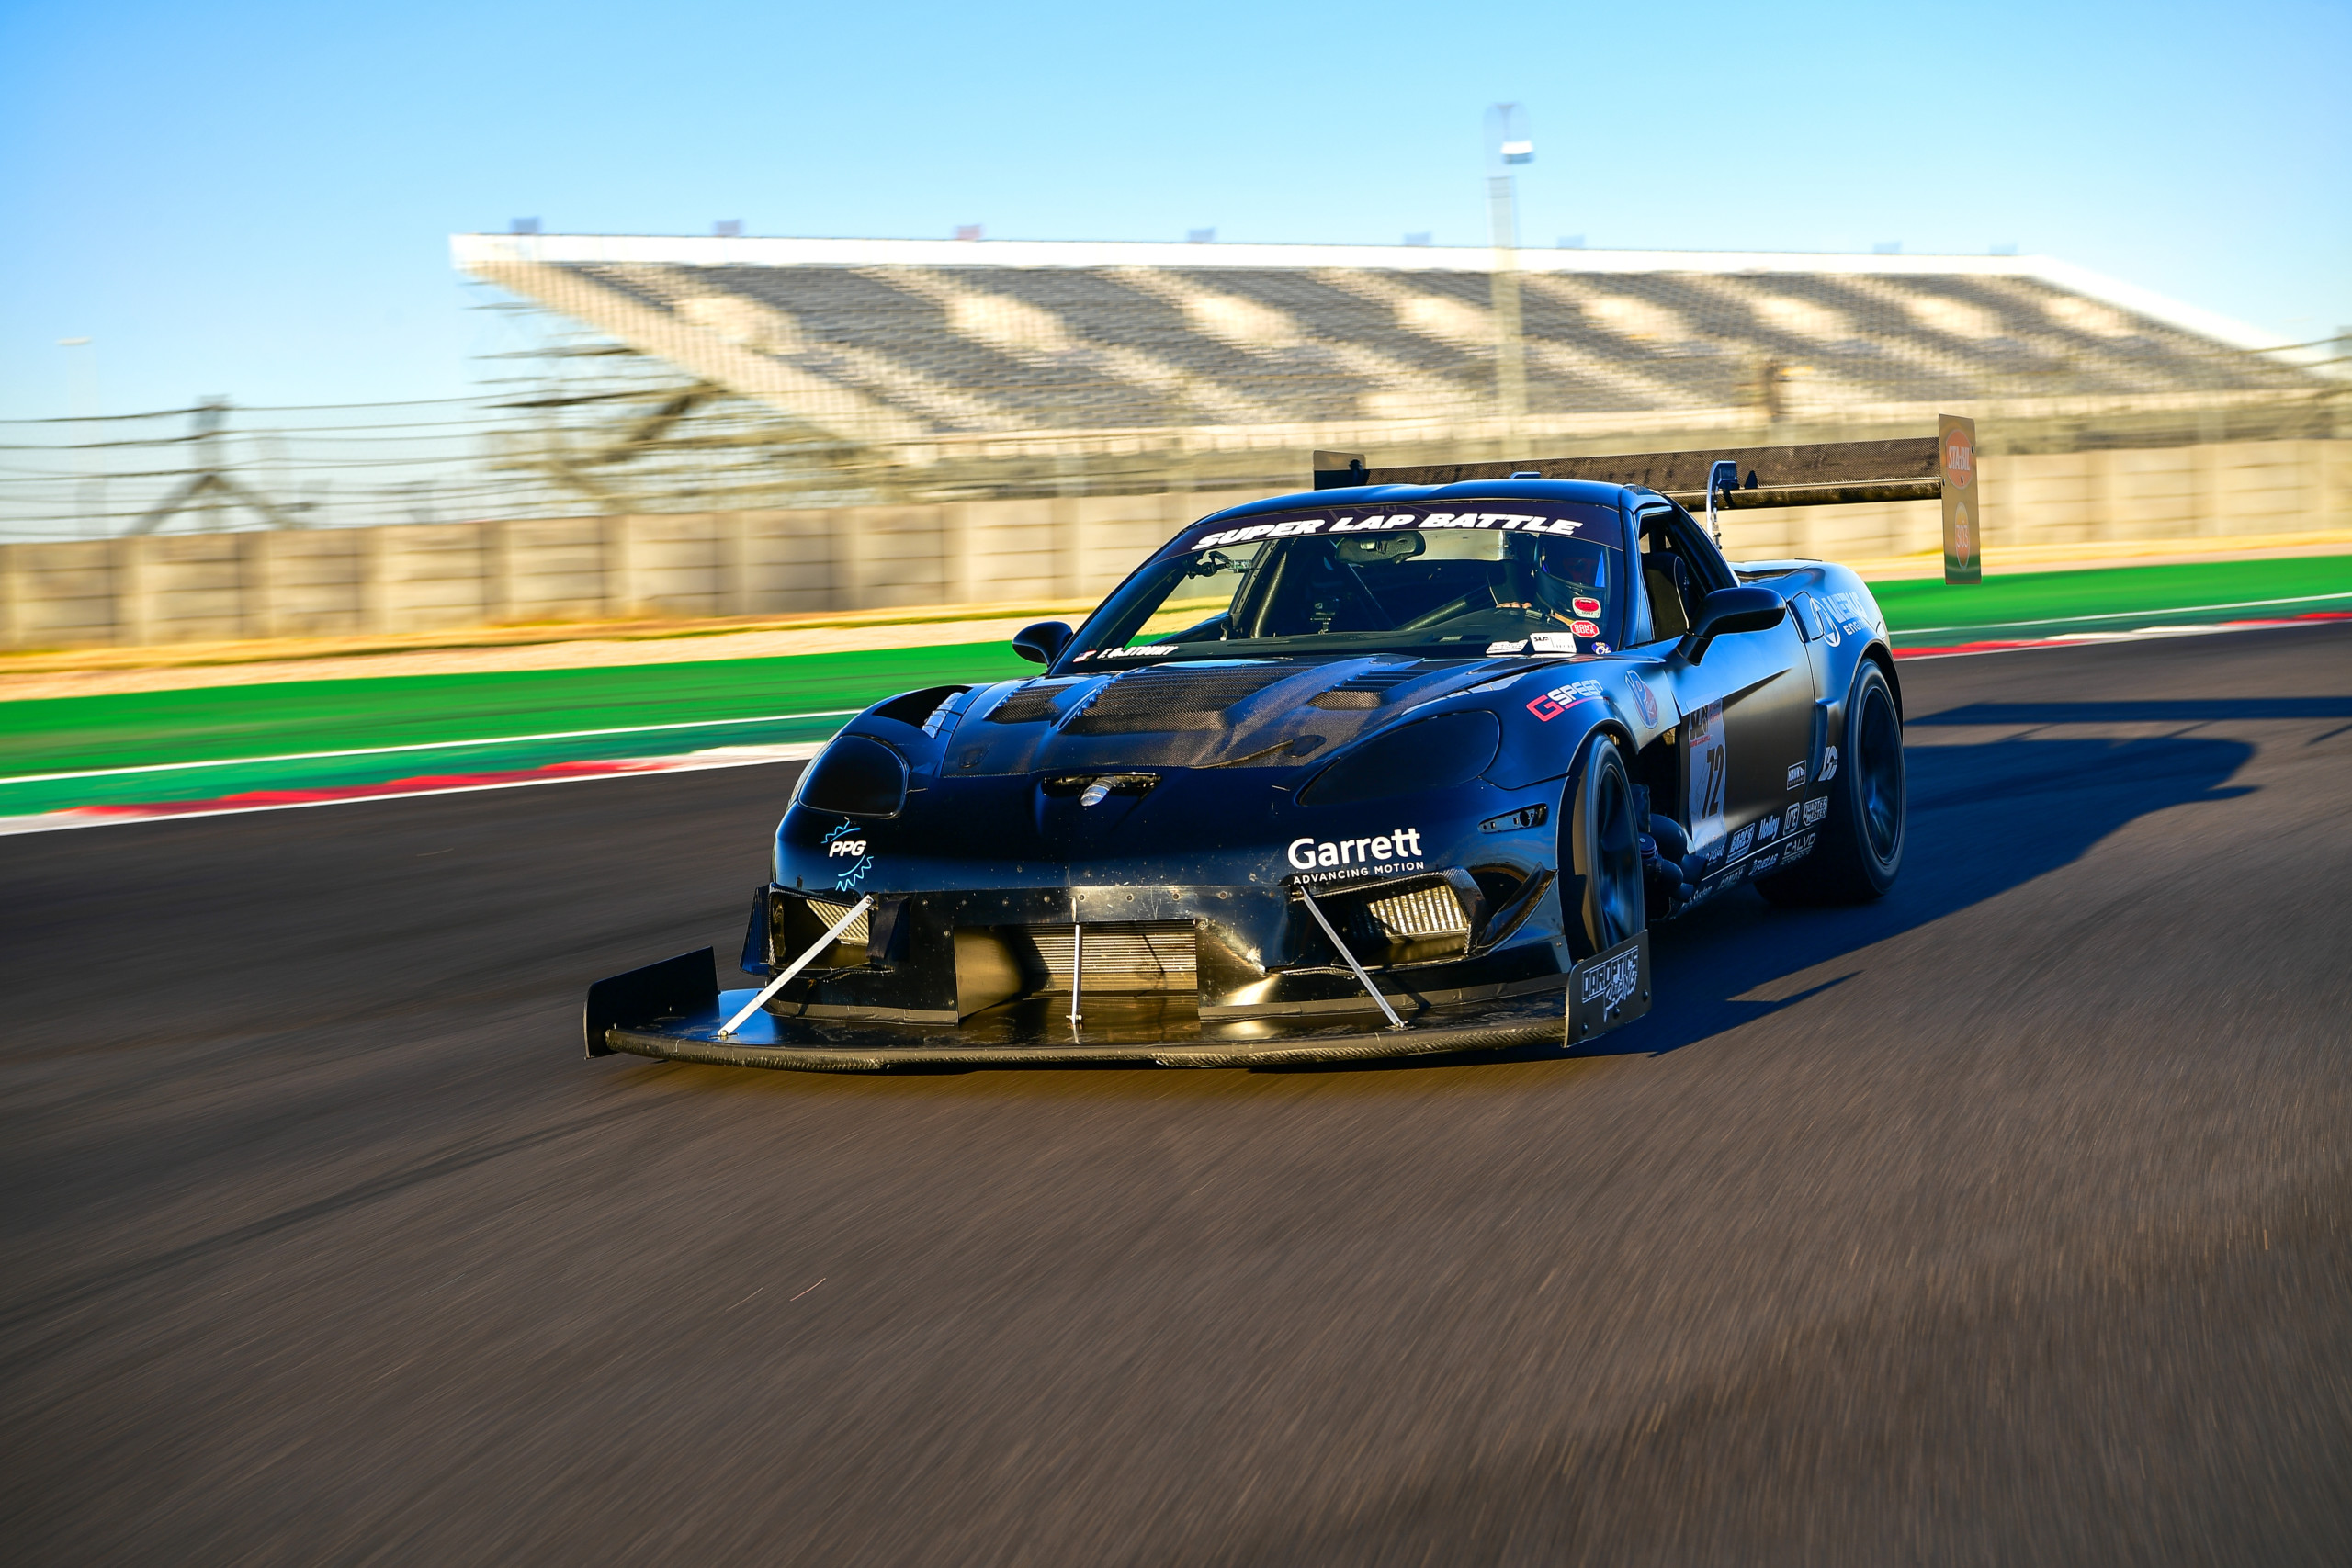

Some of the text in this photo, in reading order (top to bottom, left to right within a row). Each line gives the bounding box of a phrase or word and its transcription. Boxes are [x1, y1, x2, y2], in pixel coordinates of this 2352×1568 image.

[1948, 446, 1971, 471] STA-BIL
[1191, 513, 1583, 550] SUPER LAP BATTLE
[1955, 525, 1969, 548] 303
[1804, 798, 1827, 817] QUARTER
[1758, 815, 1780, 841] Holley
[829, 840, 867, 857] PPG
[1287, 828, 1422, 870] Garrett
[1784, 832, 1816, 856] CALVO
[1293, 862, 1424, 885] ADVANCING MOTION
